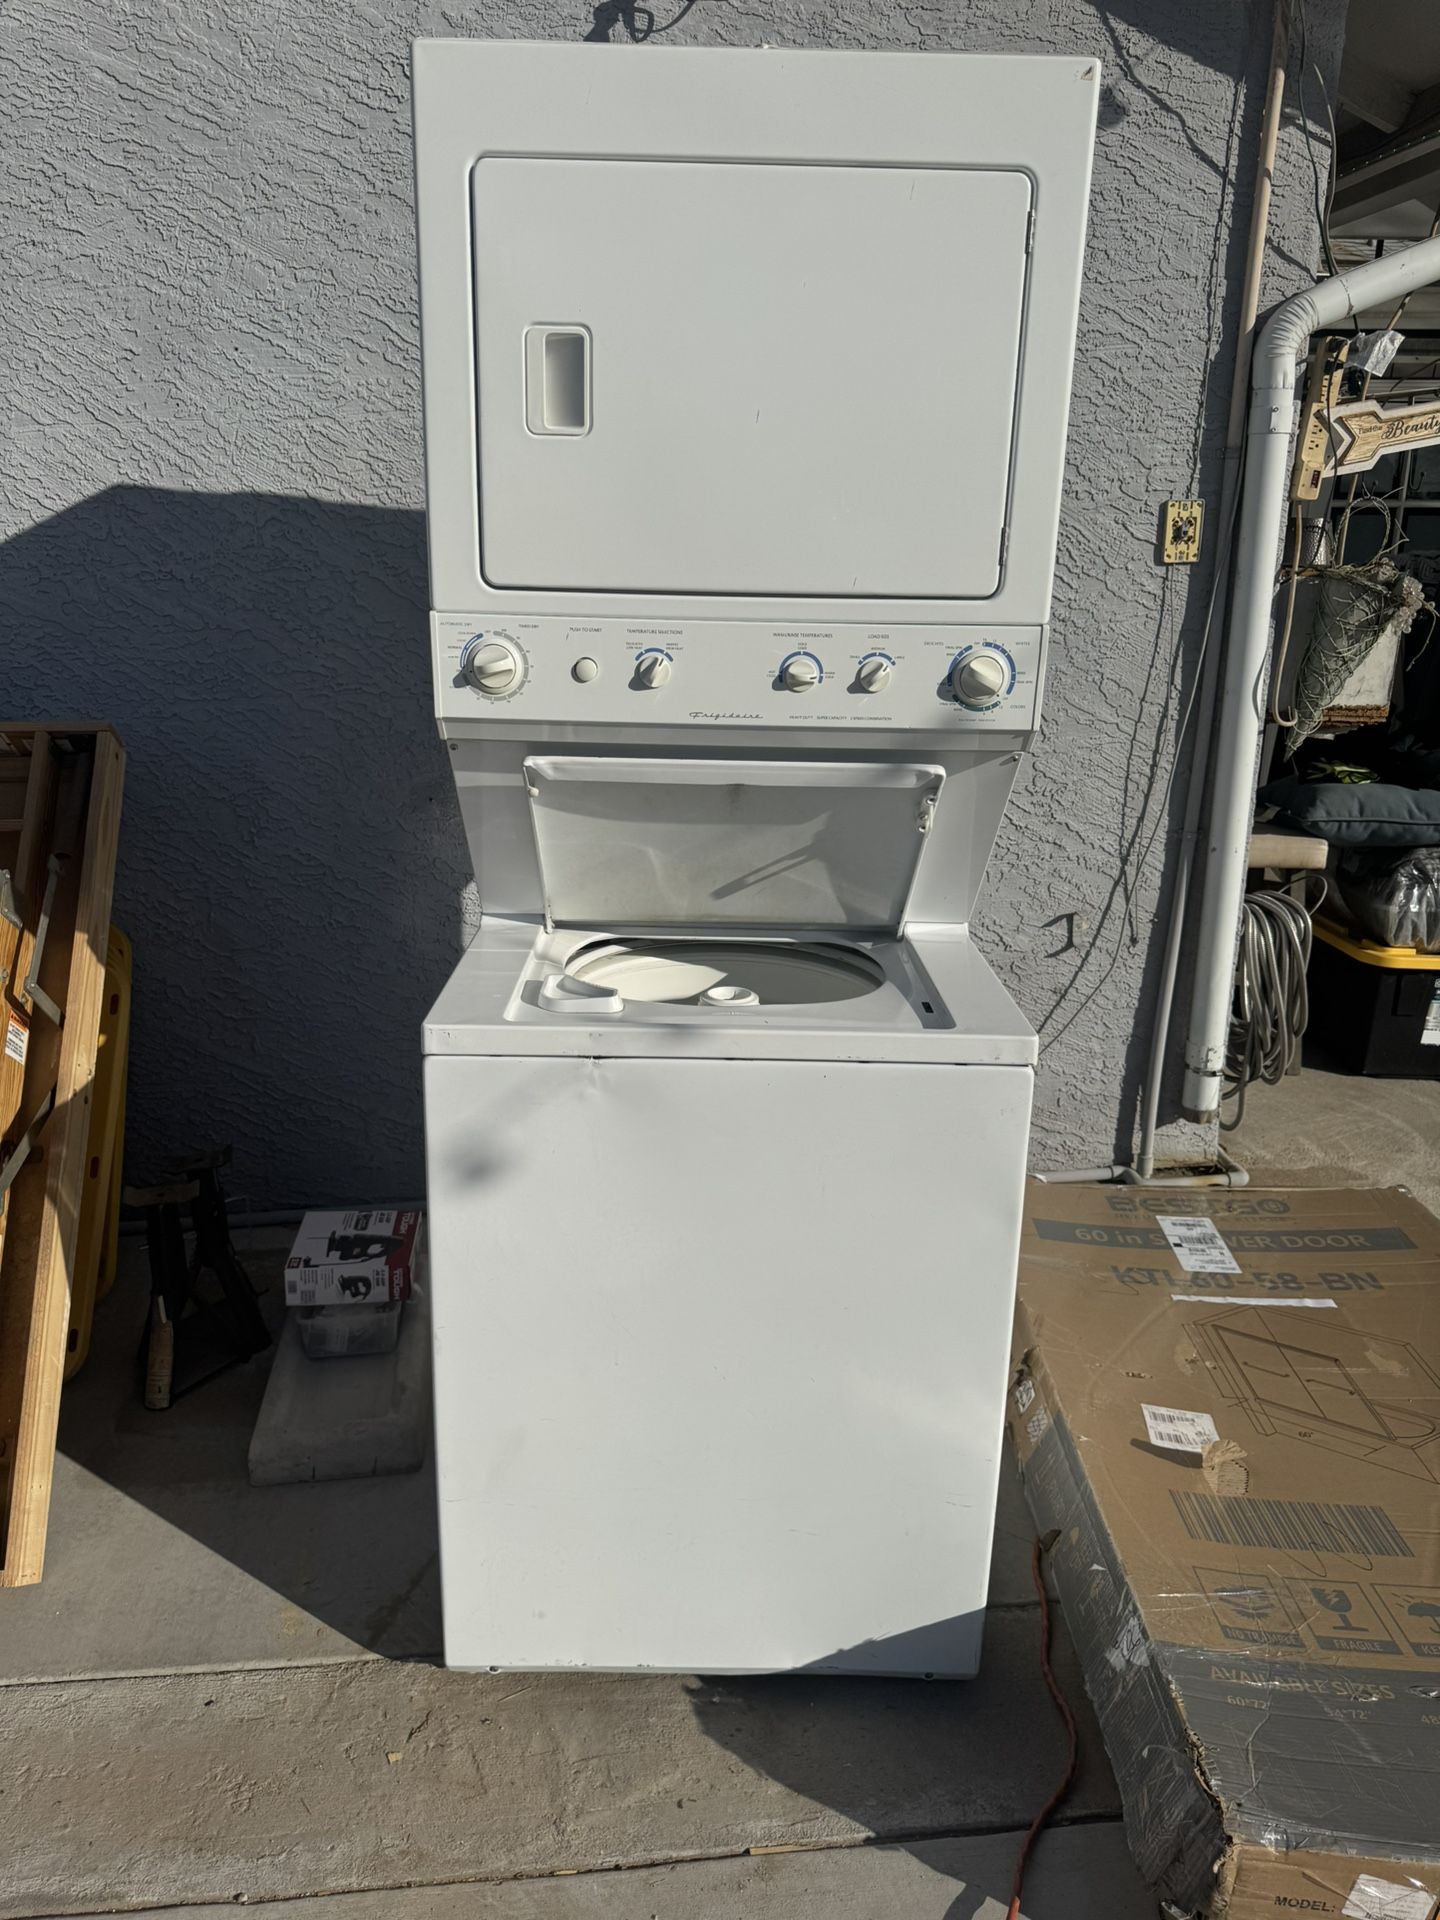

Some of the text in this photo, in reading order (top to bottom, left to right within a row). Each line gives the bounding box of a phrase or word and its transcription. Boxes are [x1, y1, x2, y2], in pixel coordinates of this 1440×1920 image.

[689, 711, 764, 721] Frigidaire
[1075, 1228, 1373, 1250] 60 in SER DOOR
[1333, 1638, 1383, 1652] FRAGILE
[1274, 1895, 1336, 1913] MODEL:
